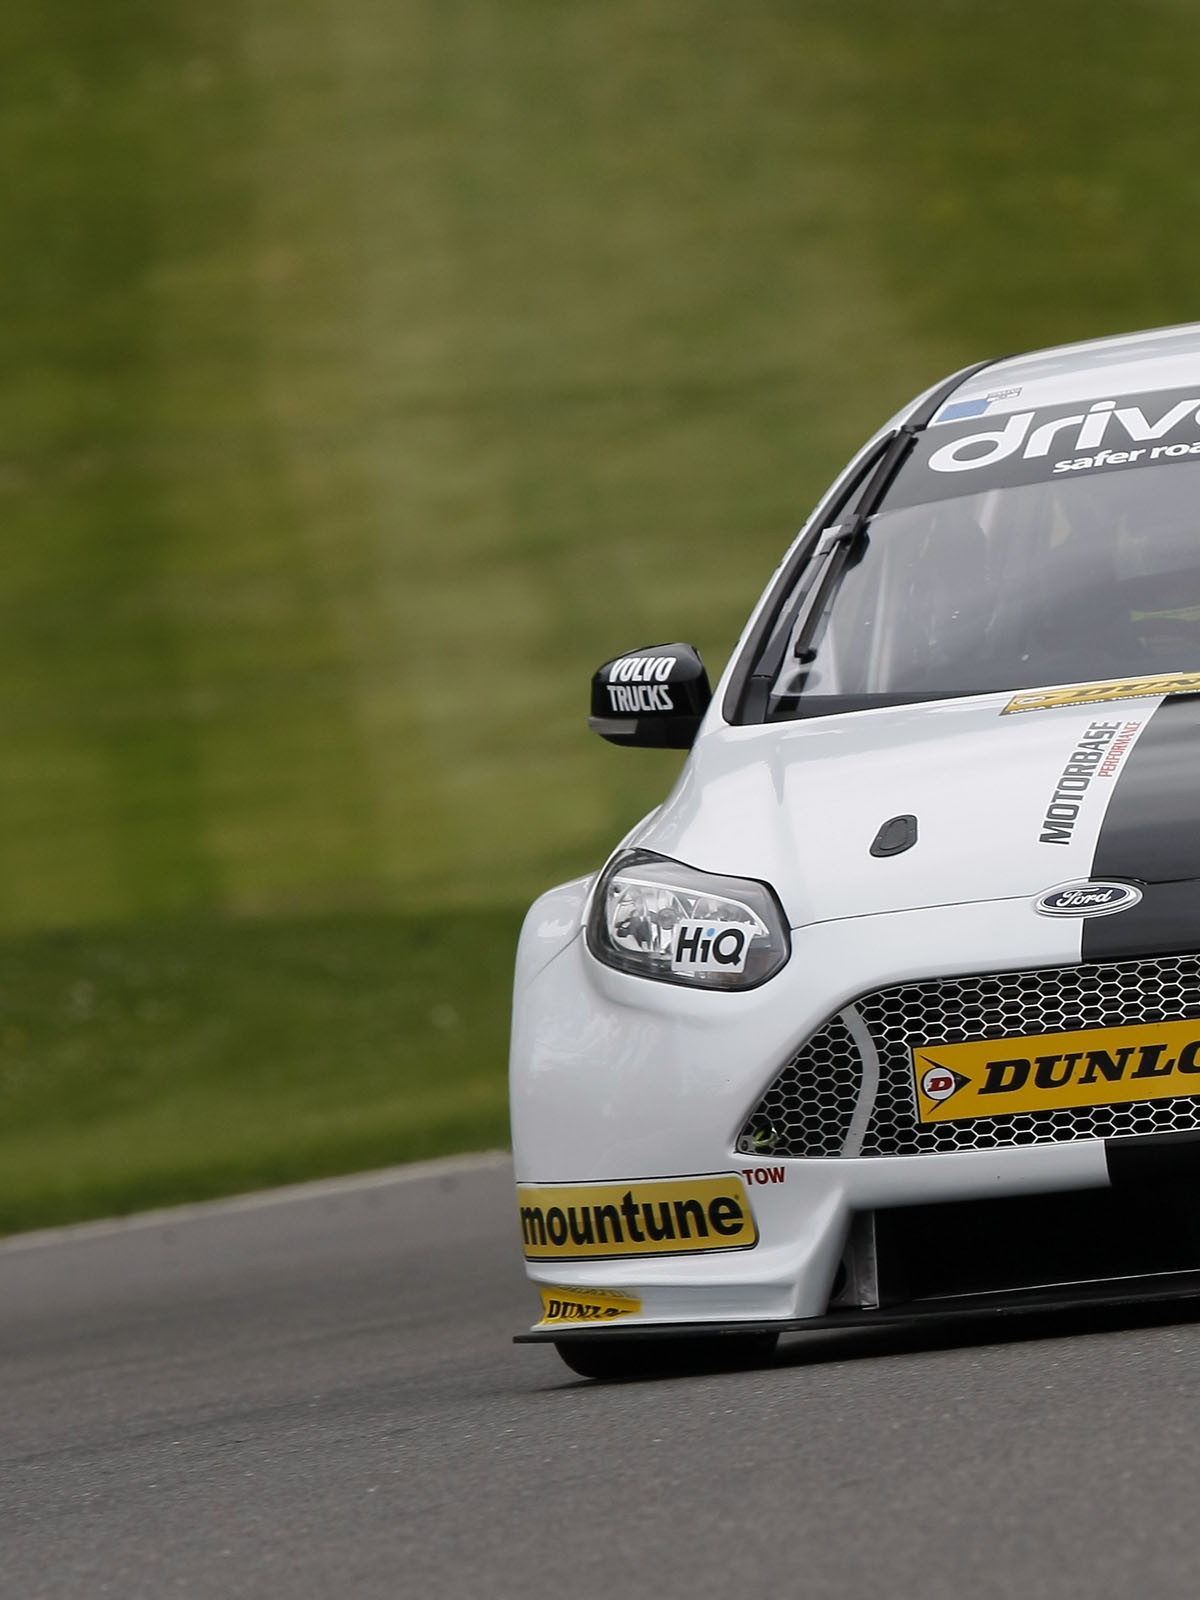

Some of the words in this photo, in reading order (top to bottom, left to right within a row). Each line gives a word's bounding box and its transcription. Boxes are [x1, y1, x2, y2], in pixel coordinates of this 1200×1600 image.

[1053, 447, 1147, 473] safer
[609, 657, 677, 682] VOLVO
[606, 684, 673, 712] TRUCKS
[1039, 722, 1122, 845] MOTORBASE
[1057, 886, 1113, 907] Ford
[675, 925, 746, 966] HiQ
[927, 1076, 953, 1092] D
[742, 1166, 785, 1185] TOW
[520, 1191, 744, 1246] mountune
